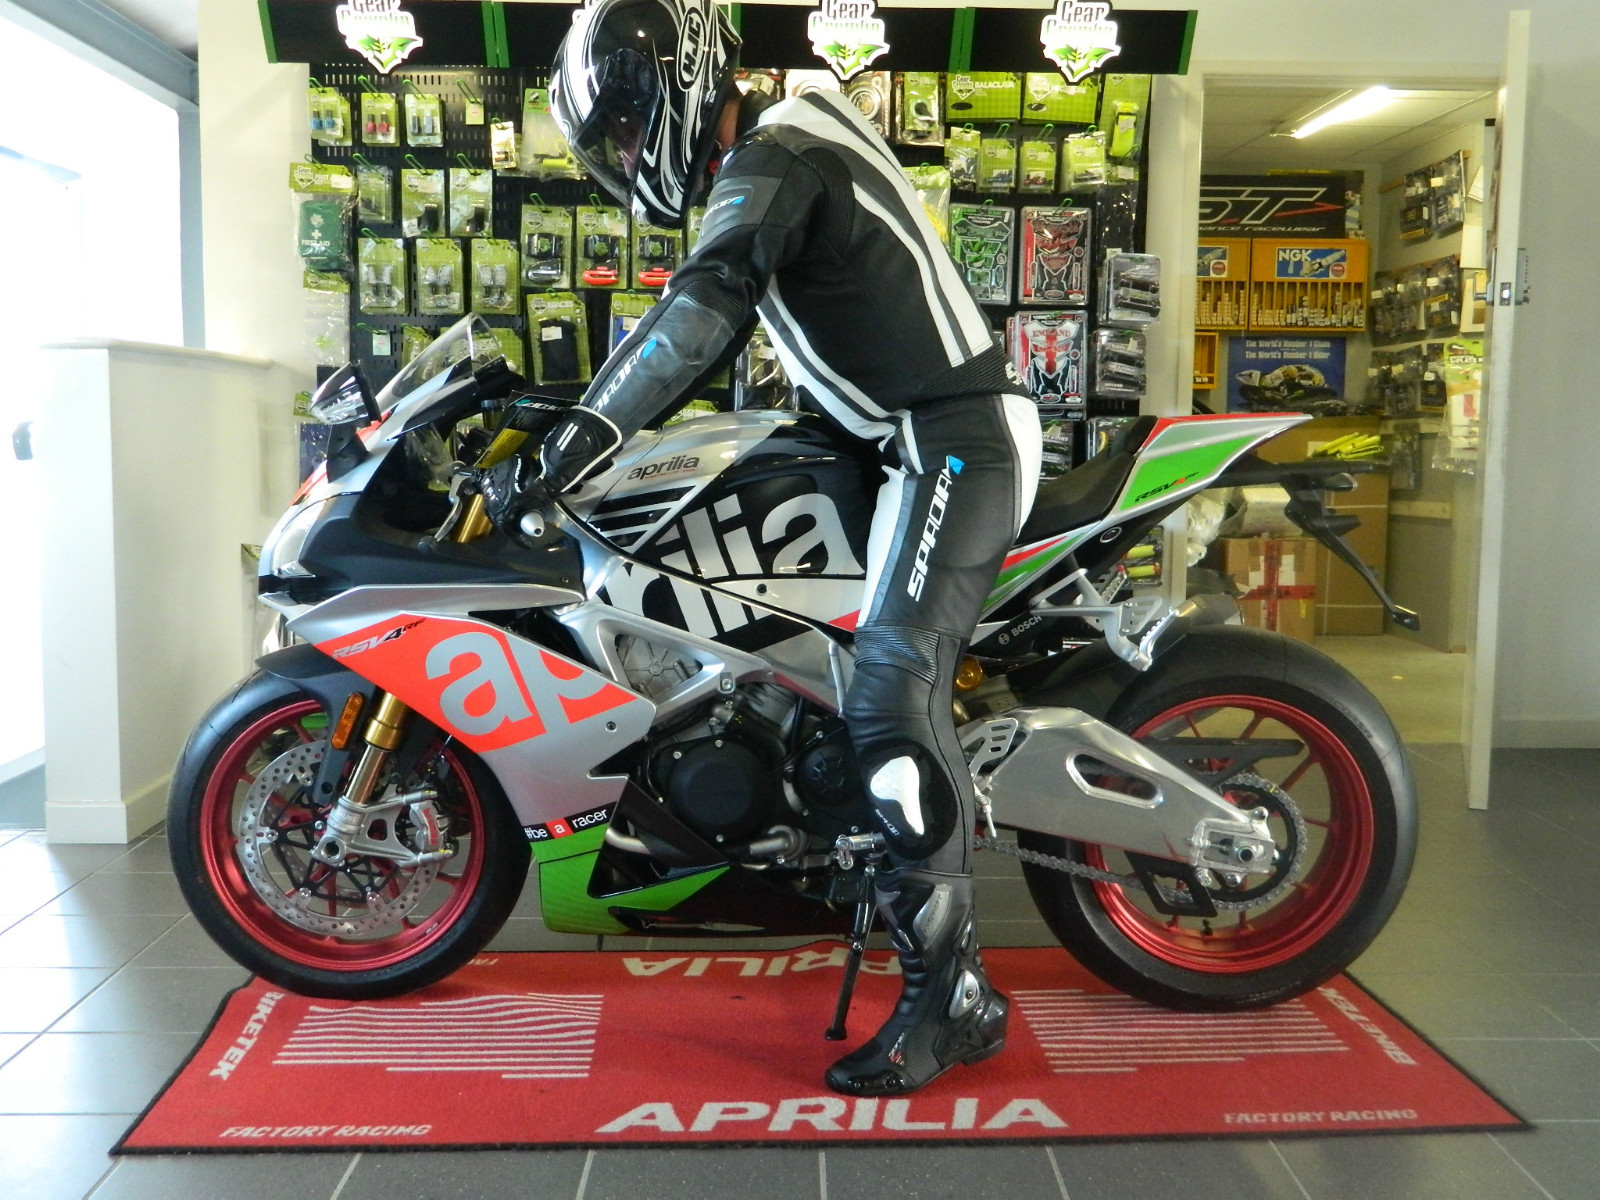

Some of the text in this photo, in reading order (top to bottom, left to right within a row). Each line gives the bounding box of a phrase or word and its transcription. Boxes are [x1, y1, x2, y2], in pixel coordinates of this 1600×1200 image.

[826, 0, 870, 20] Gear
[1061, 0, 1105, 24] Gear
[682, 13, 702, 79] HJC
[1245, 225, 1327, 233] racewear
[1278, 248, 1312, 263] NGK
[593, 355, 638, 412] PADA
[627, 454, 700, 480] aprilia
[906, 468, 953, 602] SPADA
[1011, 614, 1042, 637] BOSCH
[332, 626, 406, 660] RSV4
[524, 808, 607, 840] #be a racer
[209, 992, 287, 1081] BIKETEK
[595, 1096, 1068, 1133] APRILIA
[1224, 1108, 1418, 1124] FACTORY RACING
[219, 1124, 432, 1138] FACTORY RACING
